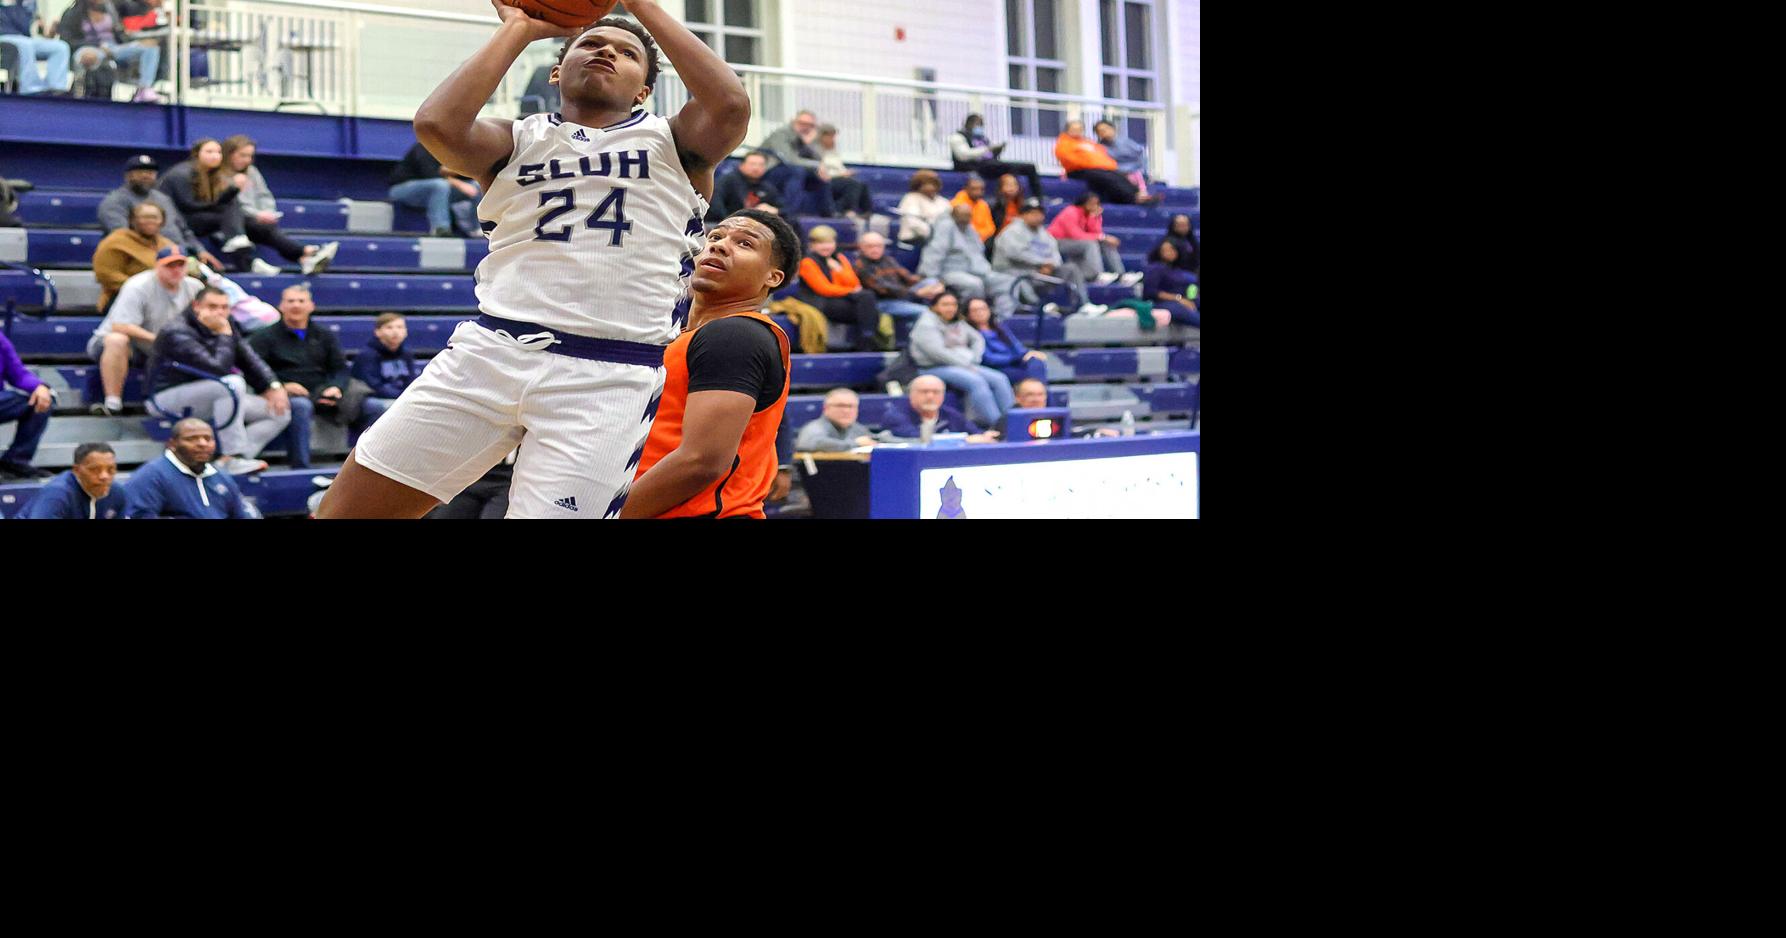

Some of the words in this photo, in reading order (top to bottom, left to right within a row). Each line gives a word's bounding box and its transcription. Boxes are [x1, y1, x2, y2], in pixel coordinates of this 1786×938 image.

[516, 150, 651, 187] SLUH
[533, 187, 633, 247] 24
[554, 500, 578, 511] adidas
